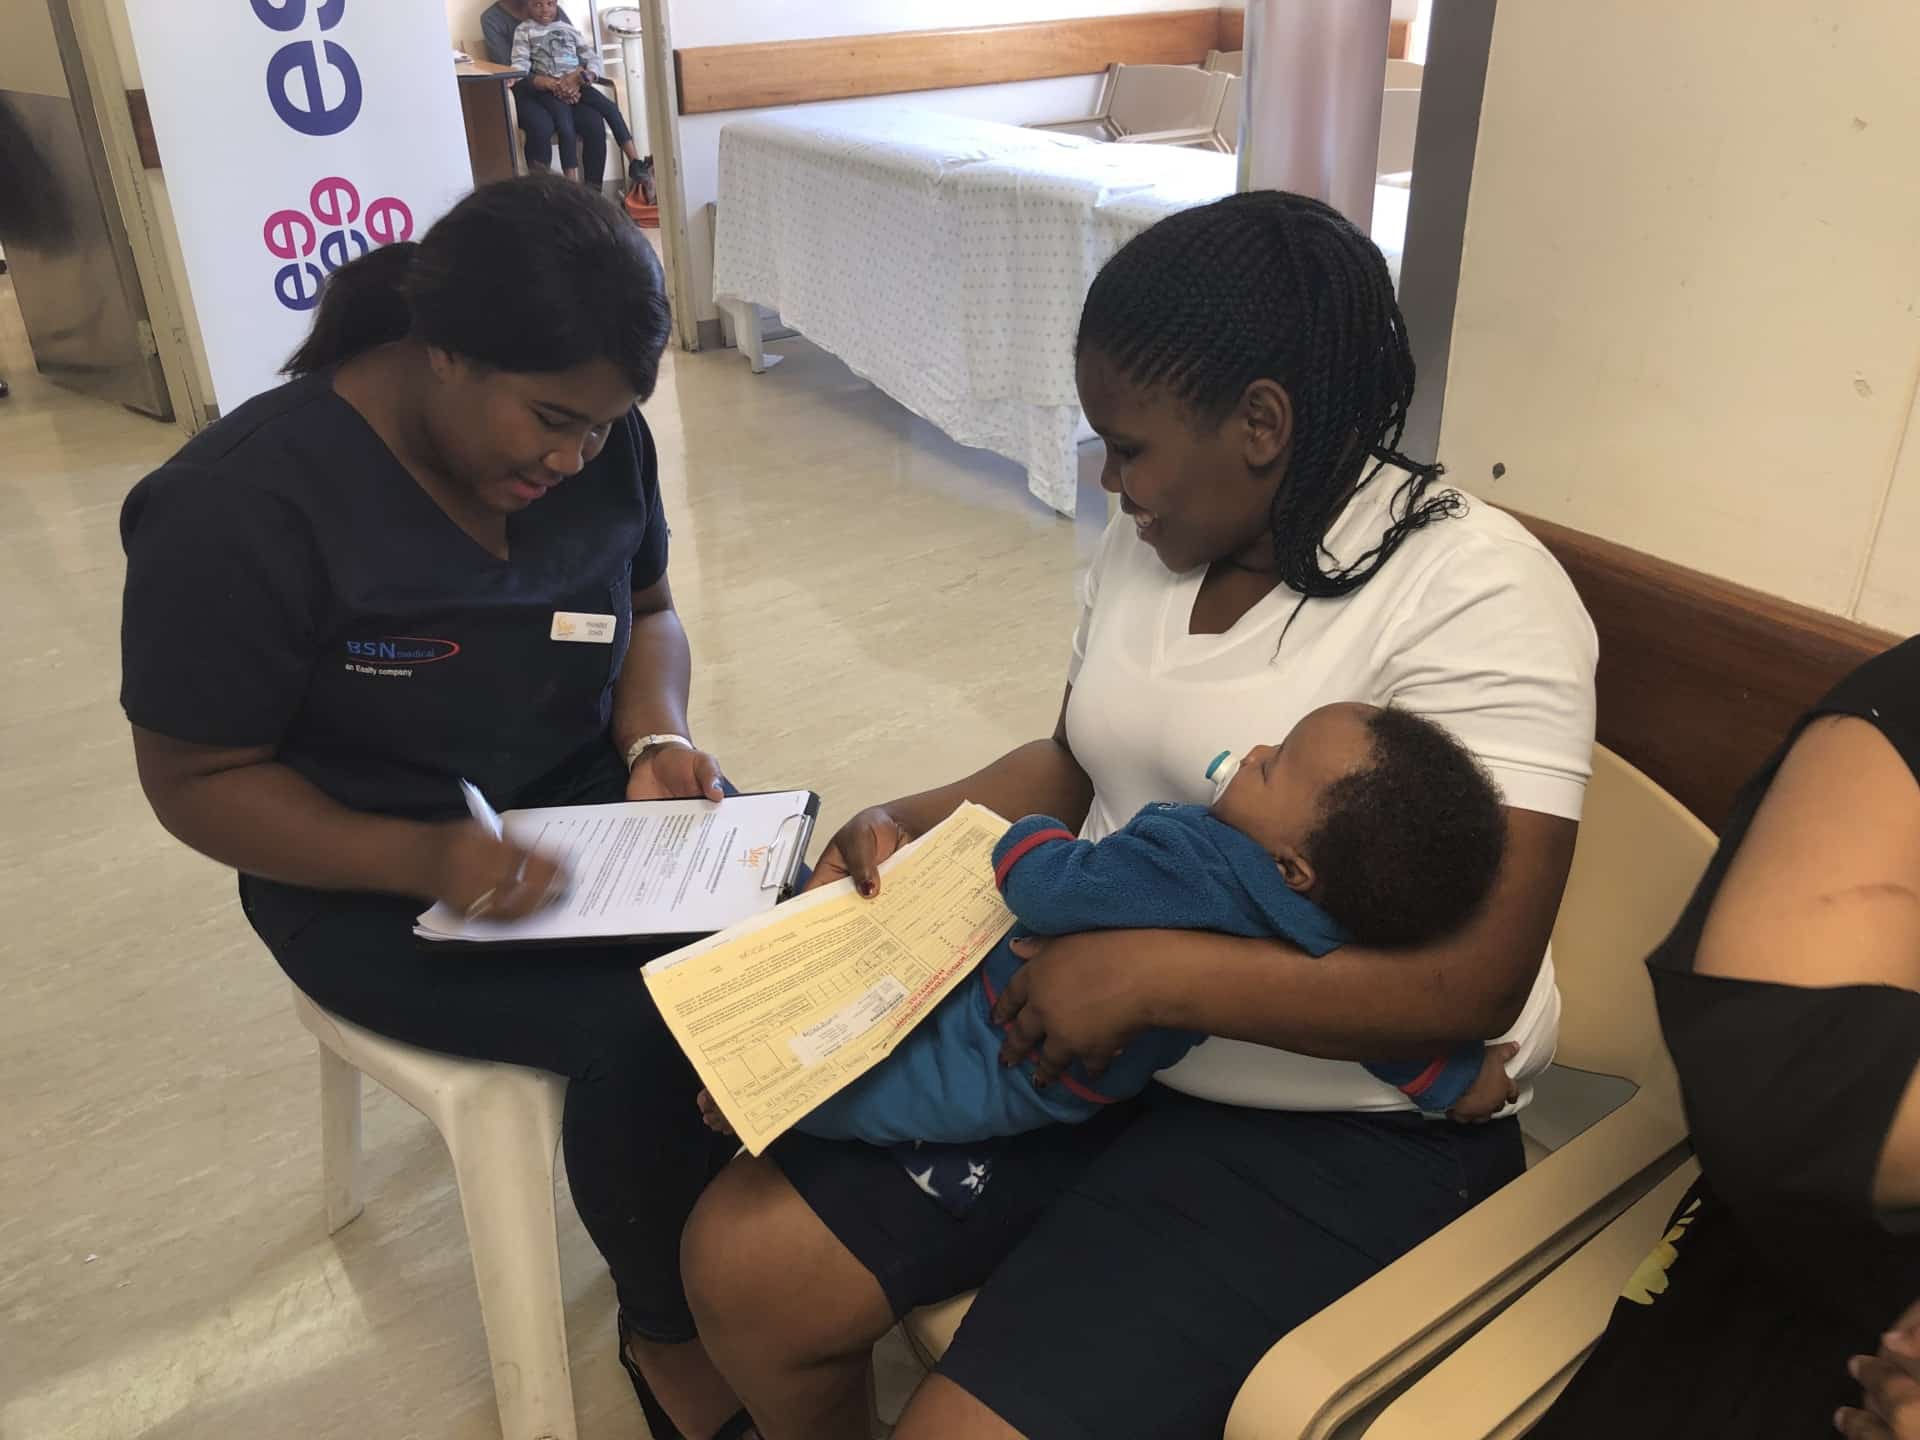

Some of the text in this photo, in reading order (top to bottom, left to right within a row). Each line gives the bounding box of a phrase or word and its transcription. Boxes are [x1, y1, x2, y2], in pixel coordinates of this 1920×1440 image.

[346, 640, 435, 659] BSN medical
[378, 667, 413, 677] company
